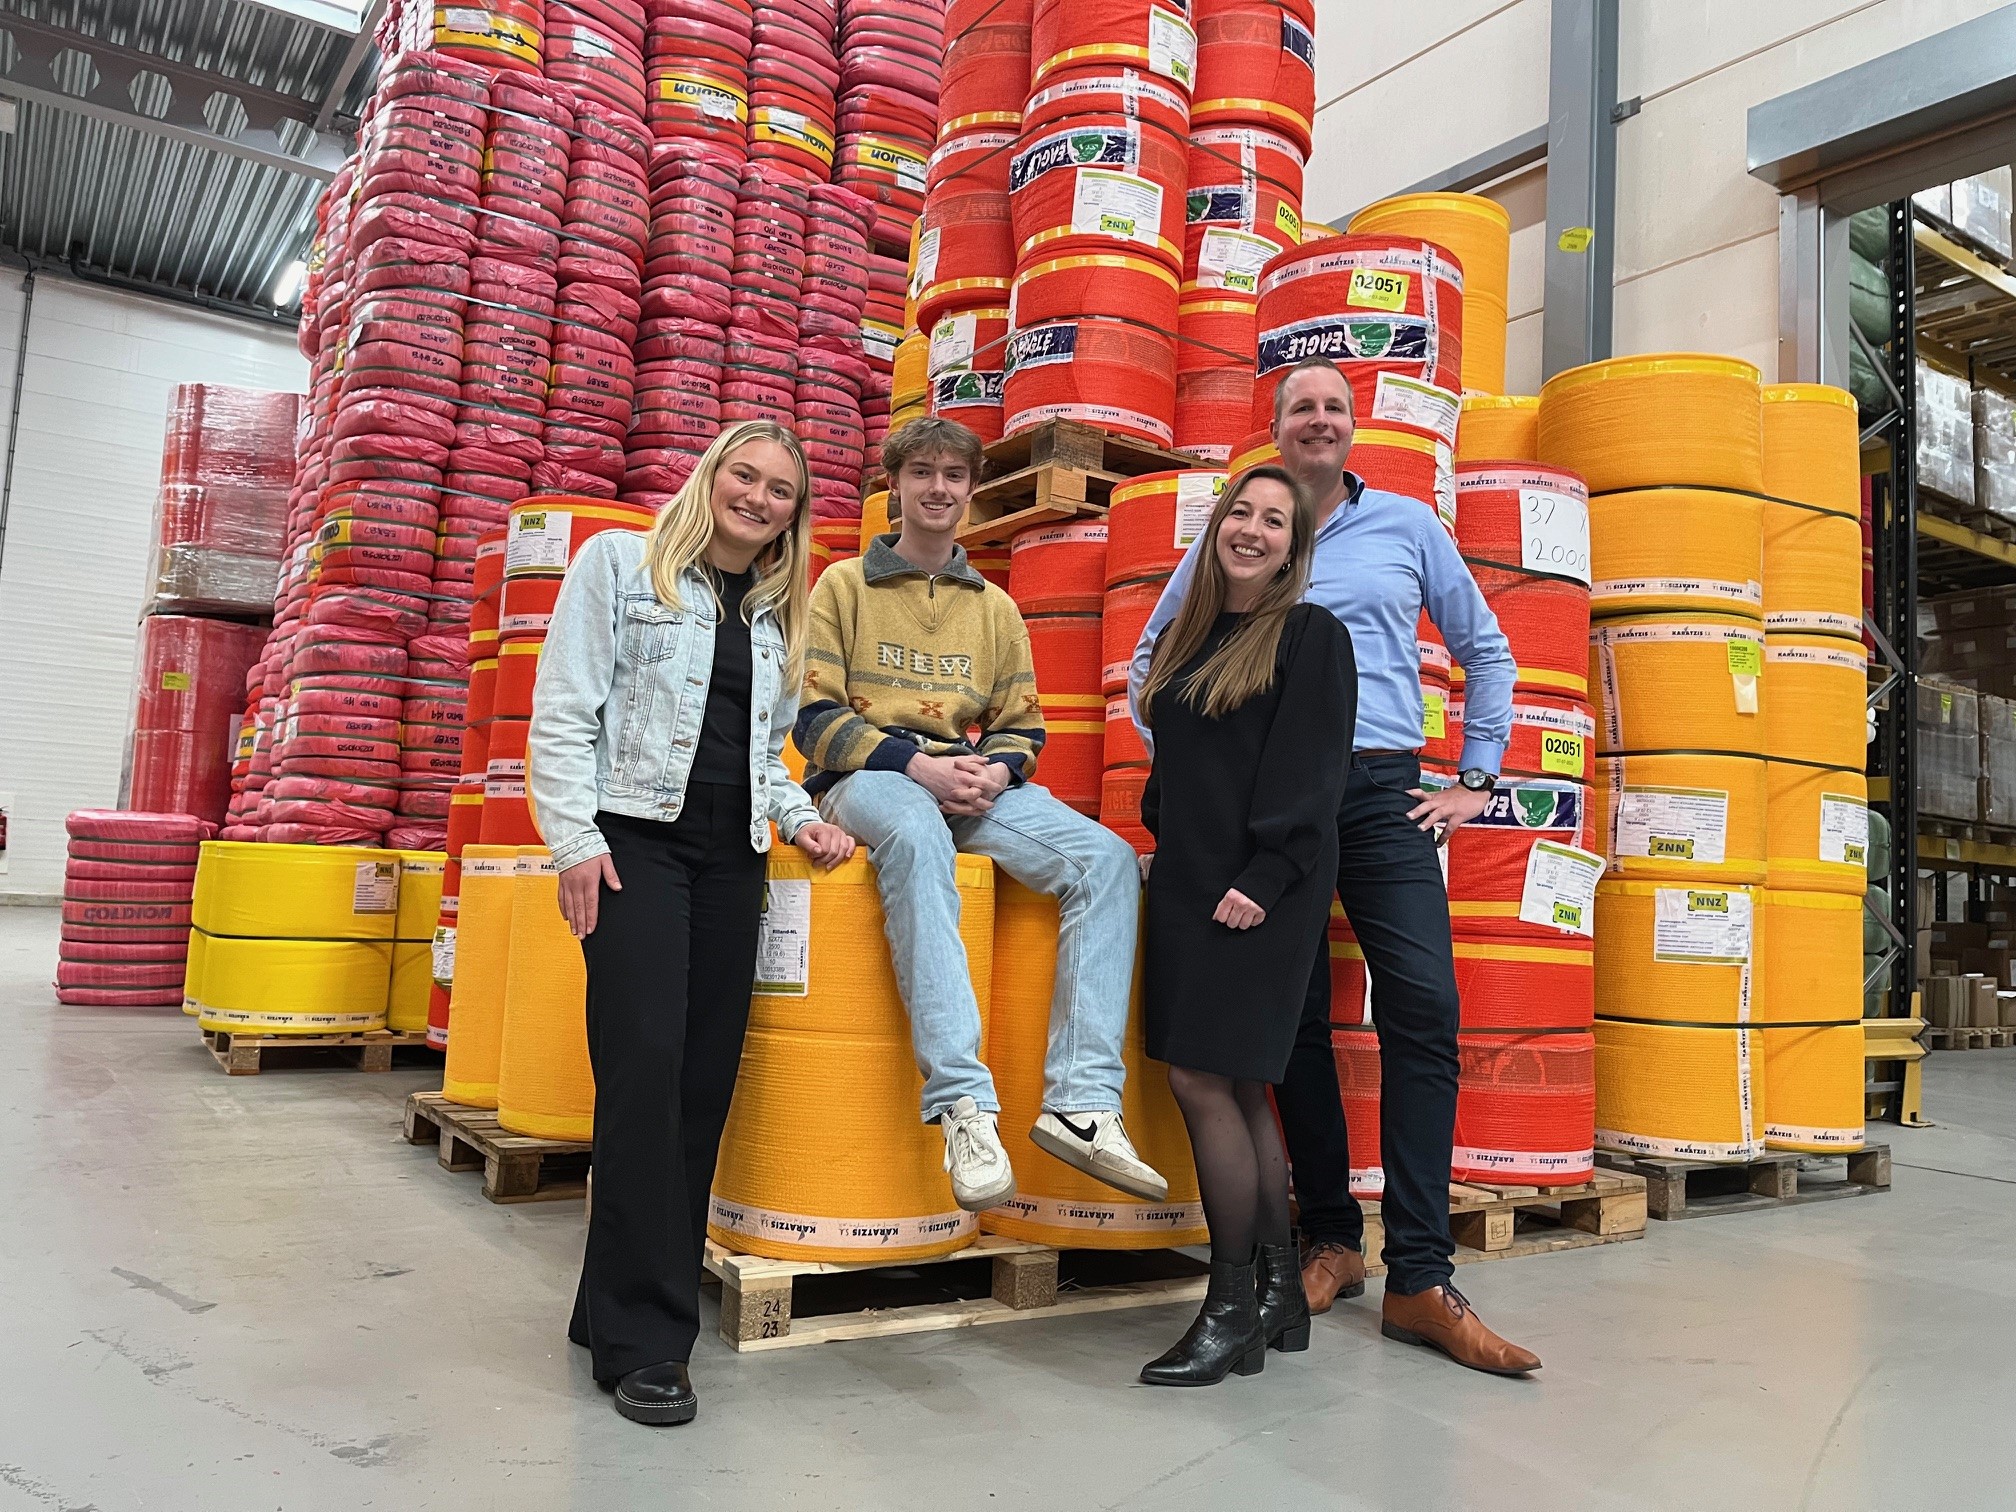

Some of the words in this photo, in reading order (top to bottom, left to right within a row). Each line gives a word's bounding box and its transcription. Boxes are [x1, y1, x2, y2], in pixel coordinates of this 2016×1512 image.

[1279, 206, 1299, 232] 02051
[1106, 220, 1128, 231] NNZ
[1320, 259, 1354, 268] KARATZIS
[1355, 274, 1402, 294] 02051
[1288, 331, 1344, 359] EAGLE
[1460, 478, 1497, 487] KARATZIS
[1522, 478, 1553, 487] KARATZIS
[1528, 496, 1555, 524] 37
[524, 517, 541, 526] NNZ
[1531, 538, 1586, 572] 2000
[879, 643, 971, 679] NEW
[1525, 714, 1559, 724] KARATZIS
[1545, 738, 1581, 758] 02051
[1657, 843, 1685, 853] NNZ
[1696, 897, 1722, 907] NNZ
[1558, 909, 1577, 922] NNZ
[1765, 1129, 1792, 1138] ARATZIS
[1618, 1138, 1650, 1149] KARATZIS
[1674, 1147, 1707, 1155] KARATZIS
[1476, 1154, 1515, 1163] KARATZIS
[1002, 1201, 1038, 1212] KARATZ
[716, 1206, 744, 1222] KARATZIS
[1069, 1209, 1115, 1220] KARATZIS
[1146, 1210, 1185, 1220] KARATZIS
[770, 1219, 816, 1235] KARATZIS
[852, 1226, 899, 1236] KARATZIS
[928, 1218, 961, 1233] KARATZIS
[763, 1300, 780, 1317] 24
[762, 1320, 779, 1338] 23
